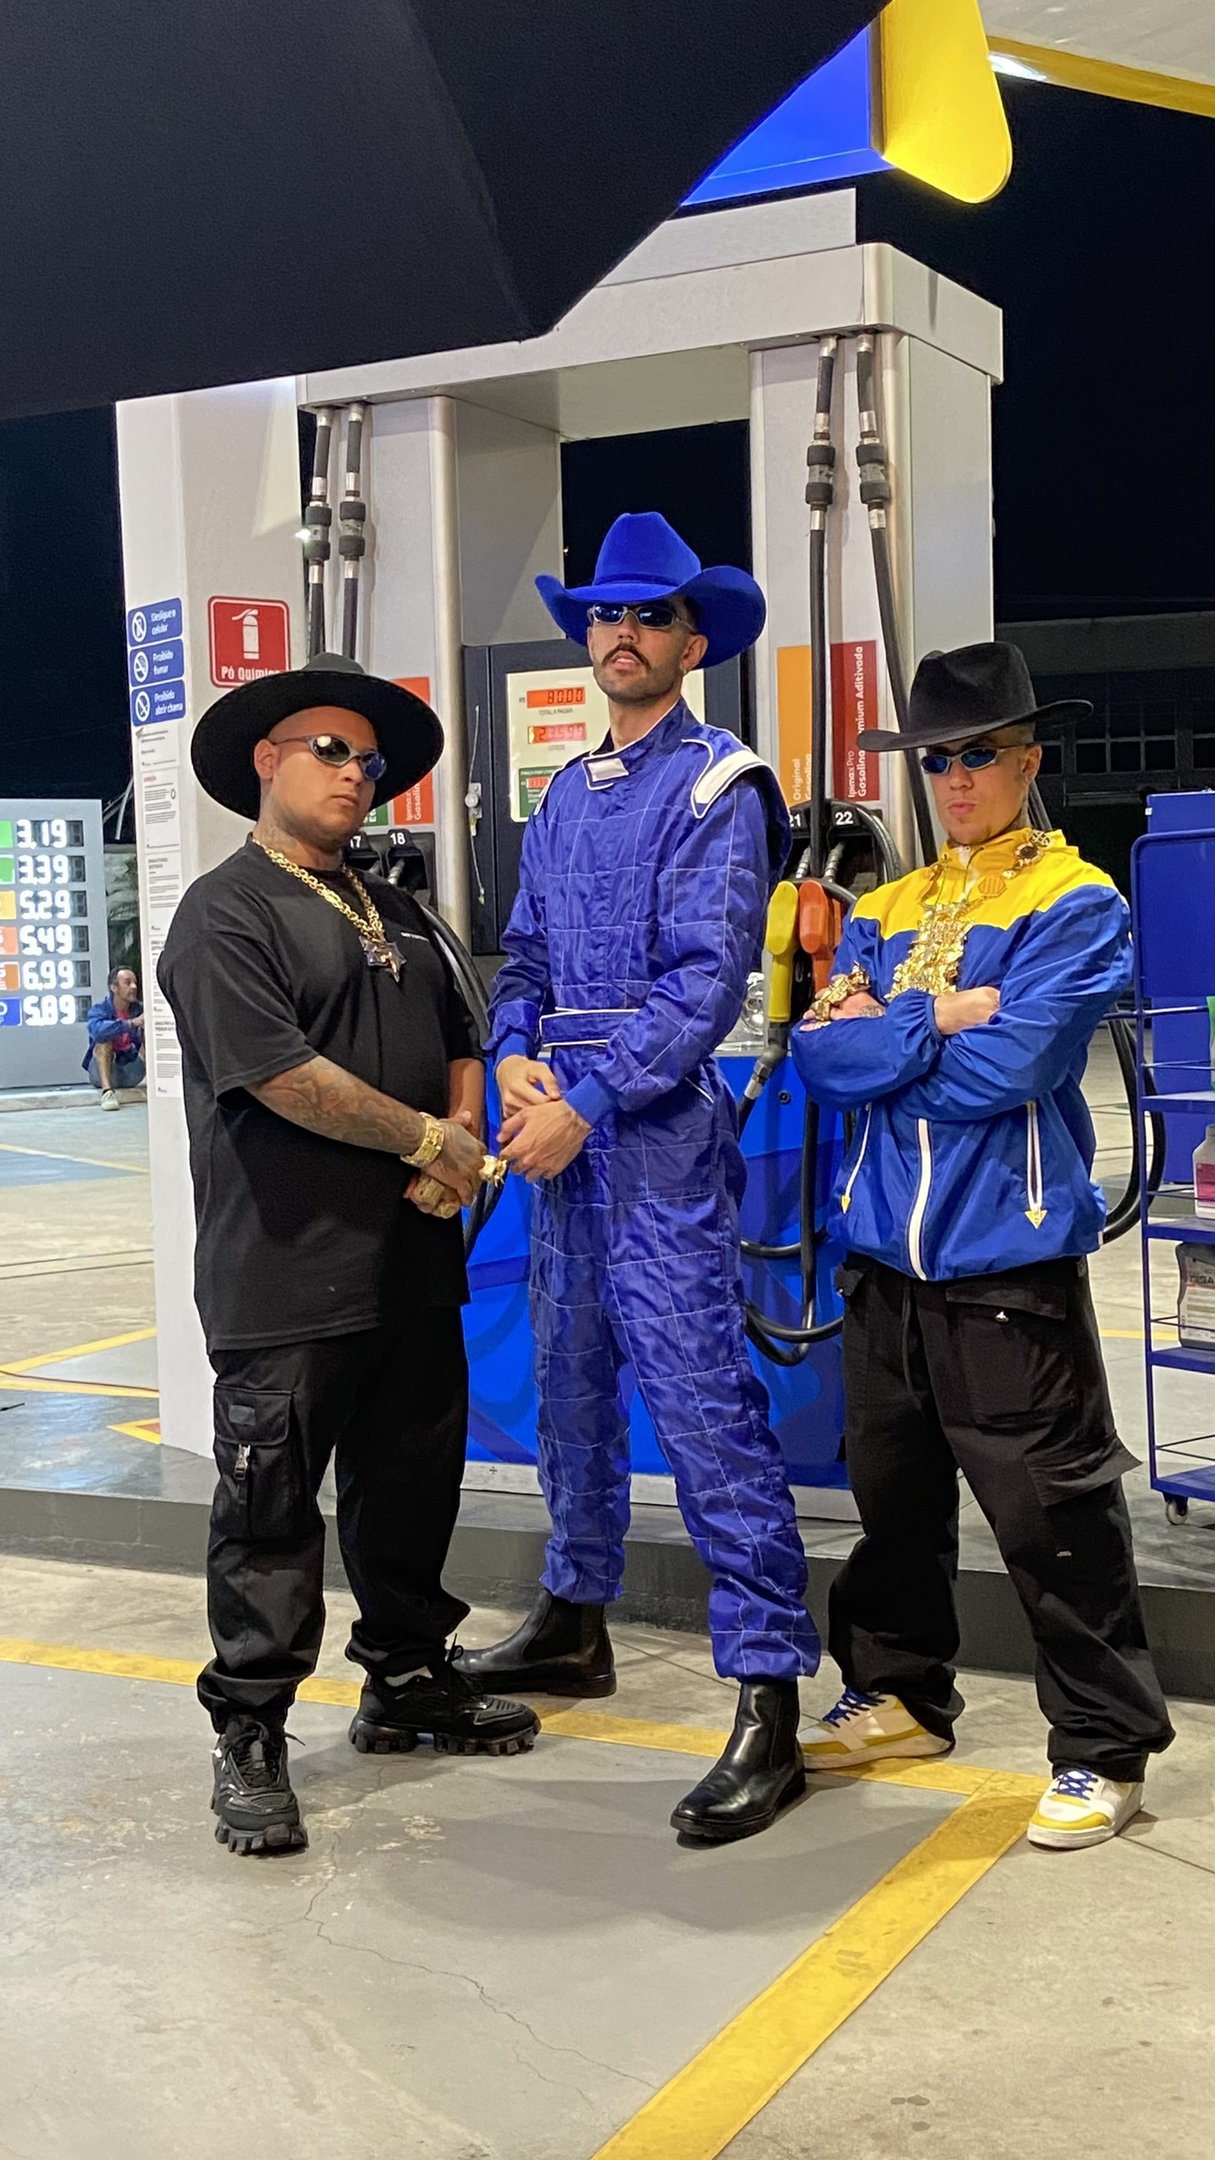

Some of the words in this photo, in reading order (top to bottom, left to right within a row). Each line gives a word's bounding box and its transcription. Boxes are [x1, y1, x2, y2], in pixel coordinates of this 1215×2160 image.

[153, 650, 174, 662] Proibido
[154, 665, 169, 676] fumar
[221, 666, 235, 680] Pó
[238, 667, 284, 681] Quími
[854, 646, 864, 699] Aditivada
[154, 690, 176, 703] Proibido
[856, 701, 865, 734] mium
[846, 750, 855, 766] Pro
[792, 758, 803, 801] Original
[857, 750, 866, 797] Gasolina
[847, 767, 857, 798] Ipimax
[835, 811, 854, 826] 22
[390, 832, 406, 846] 18
